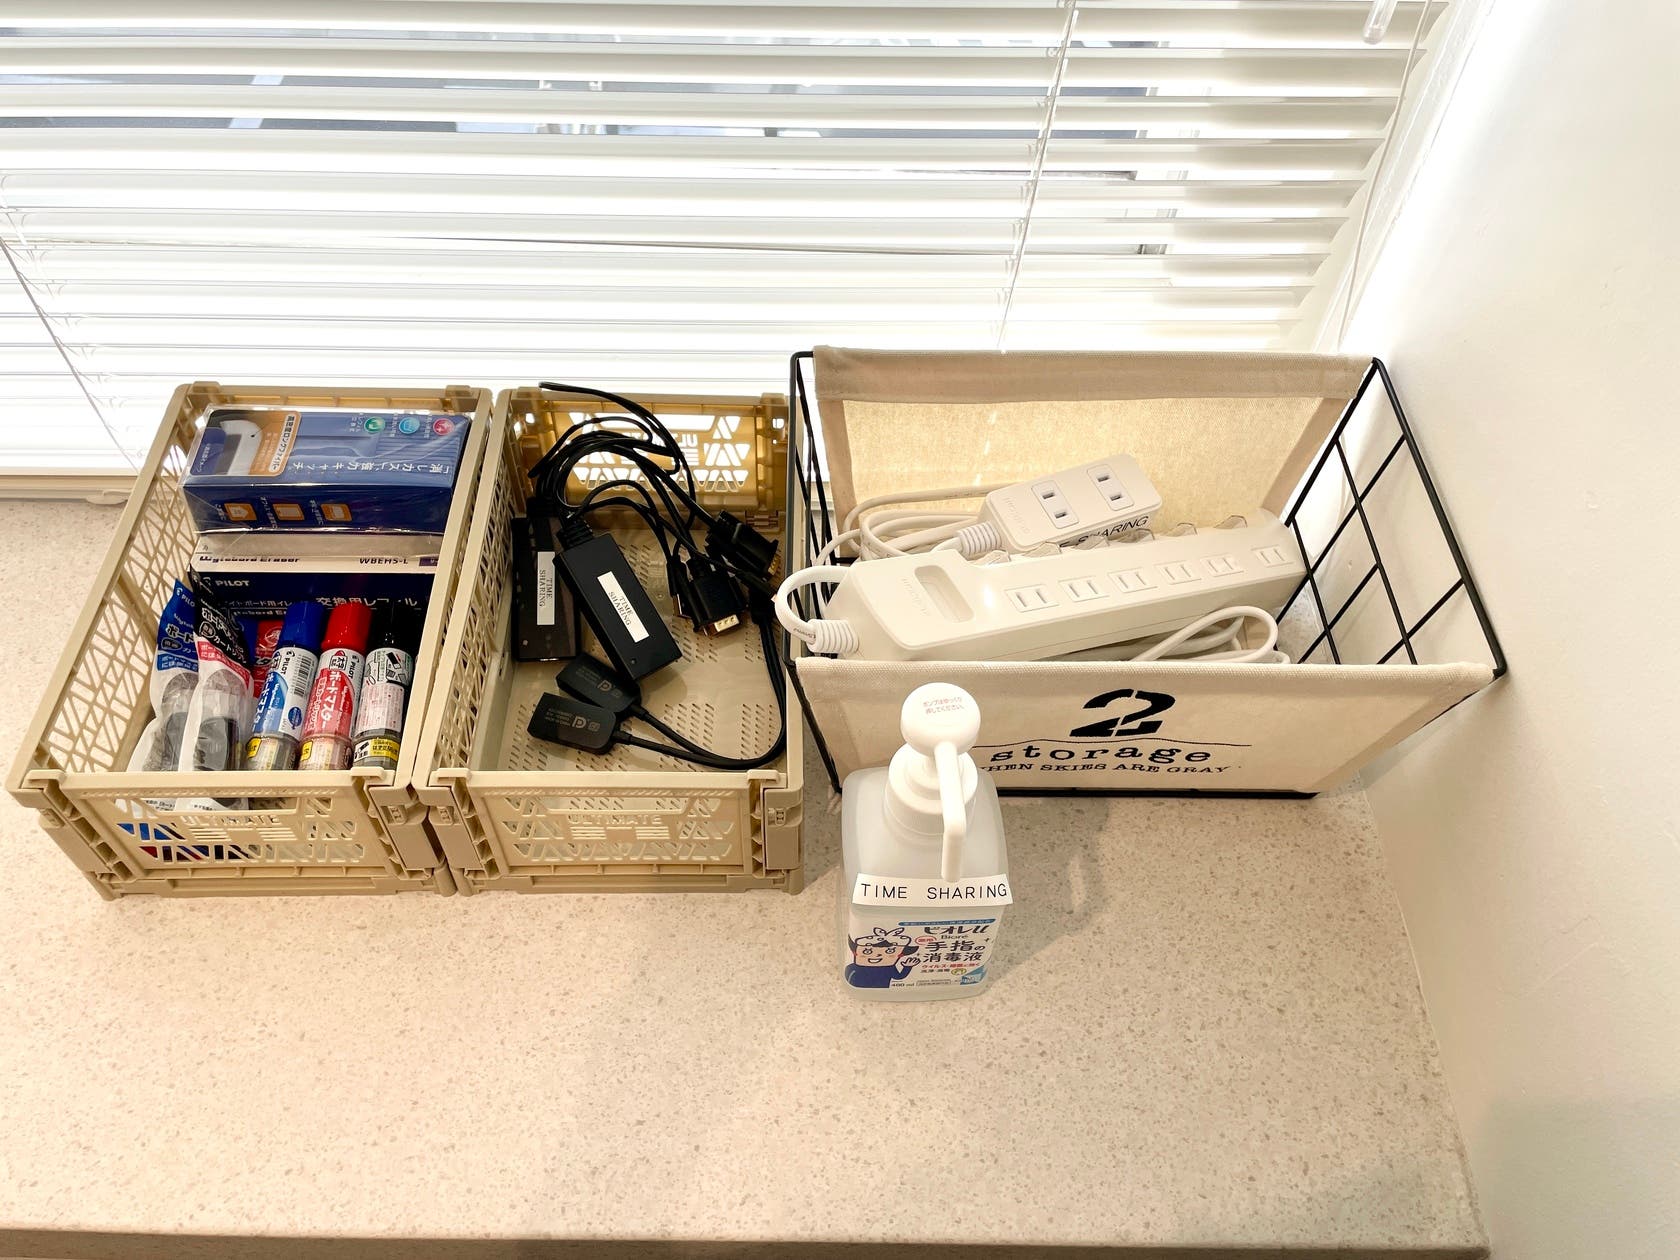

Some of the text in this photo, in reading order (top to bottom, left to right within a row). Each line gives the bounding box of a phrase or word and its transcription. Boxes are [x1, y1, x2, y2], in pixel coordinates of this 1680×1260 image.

[1076, 516, 1149, 546] SARING
[538, 569, 546, 607] SHARING
[608, 591, 632, 626] SHARING
[620, 595, 634, 617] TIME
[280, 658, 290, 675] PILOT
[348, 661, 357, 679] PILOT
[321, 670, 342, 729] ボードマスター
[1069, 688, 1177, 738] 2
[991, 745, 1212, 765] storage
[979, 763, 1230, 774] HEN SKIES ARE GRAY
[568, 815, 663, 825] ULTIMATE
[861, 883, 1007, 900] TIME SHARING
[925, 940, 986, 952] 手指の
[922, 952, 983, 963] 消毒液
